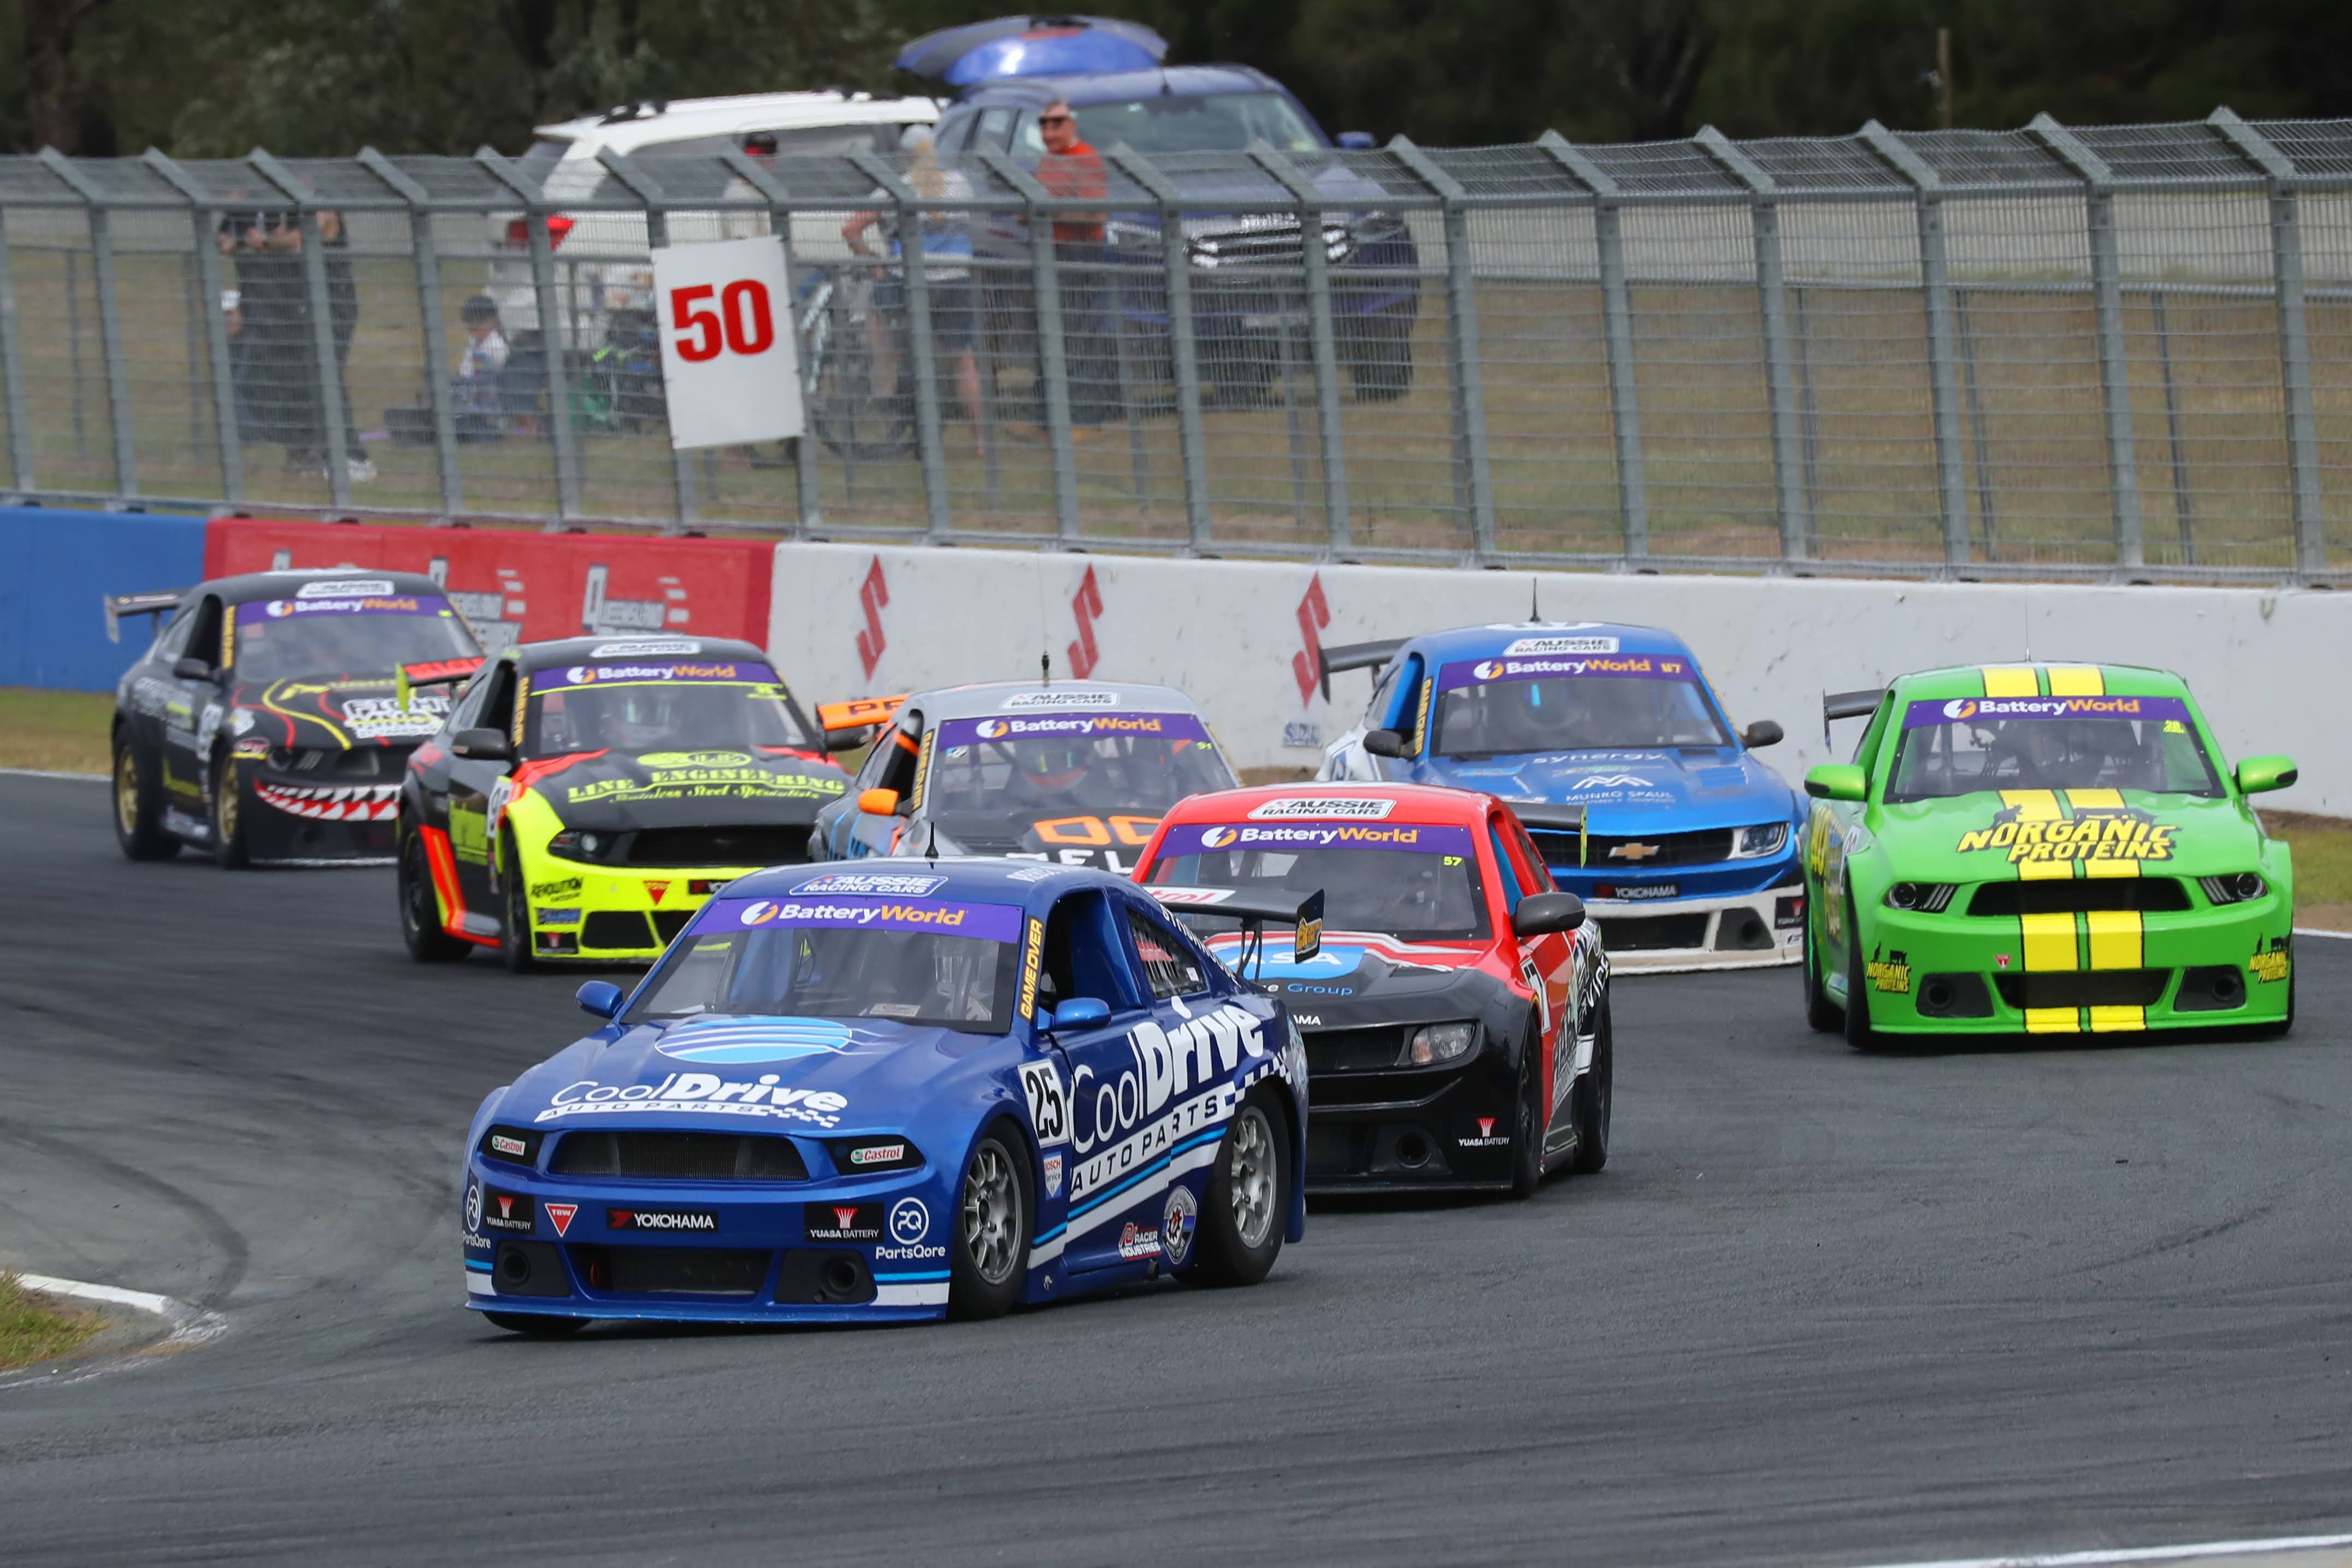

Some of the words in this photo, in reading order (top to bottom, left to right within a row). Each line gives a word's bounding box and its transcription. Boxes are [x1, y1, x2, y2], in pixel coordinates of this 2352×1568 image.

[670, 279, 775, 363] 50
[597, 664, 736, 680] BatteryWorld
[1507, 659, 1652, 674] BatteryWorld
[1979, 699, 2141, 715] BatteryWorld
[1011, 717, 1162, 733] BatteryWorld
[568, 780, 634, 798] LINE
[651, 769, 845, 791] ENGINEERING
[1262, 807, 1328, 816] RACING
[1333, 807, 1382, 816] CARS
[1289, 800, 1387, 809] AUSSIE
[1240, 827, 1418, 845] BatteryWorld
[1956, 820, 2179, 852] NORGANIC
[2007, 841, 2171, 862] PROTEINS
[1443, 856, 1463, 866] 57
[803, 883, 874, 892] RACING
[876, 885, 928, 894] CARS
[834, 875, 938, 886] AUSSIE
[1614, 885, 1678, 899] YOKOHAMA
[779, 904, 965, 926] BatteryWorld
[1287, 983, 1353, 997] Group
[1066, 995, 1264, 1154] CoolDrive
[551, 1072, 848, 1112] CoolDrive
[547, 1103, 629, 1118] AUTO
[644, 1102, 756, 1113] PARTS
[1025, 1067, 1063, 1139] 25
[499, 1138, 523, 1153] Castrol
[1071, 1143, 1133, 1195] AUTO
[1141, 1094, 1218, 1156] PARTS
[1458, 1137, 1483, 1147] YUASA
[1484, 1136, 1510, 1146] BATTERY
[864, 1147, 901, 1161] Castrol
[551, 1209, 572, 1217] TOW
[634, 1212, 715, 1229] YOKOHAMA
[486, 1216, 504, 1227] YUASA
[504, 1221, 532, 1230] BATTERY
[810, 1229, 842, 1239] YUASA
[843, 1229, 879, 1239] BATTERY
[1134, 1230, 1158, 1245] RACER
[875, 1243, 946, 1260] PartsQore
[1120, 1241, 1162, 1259] INDUSTRIES
